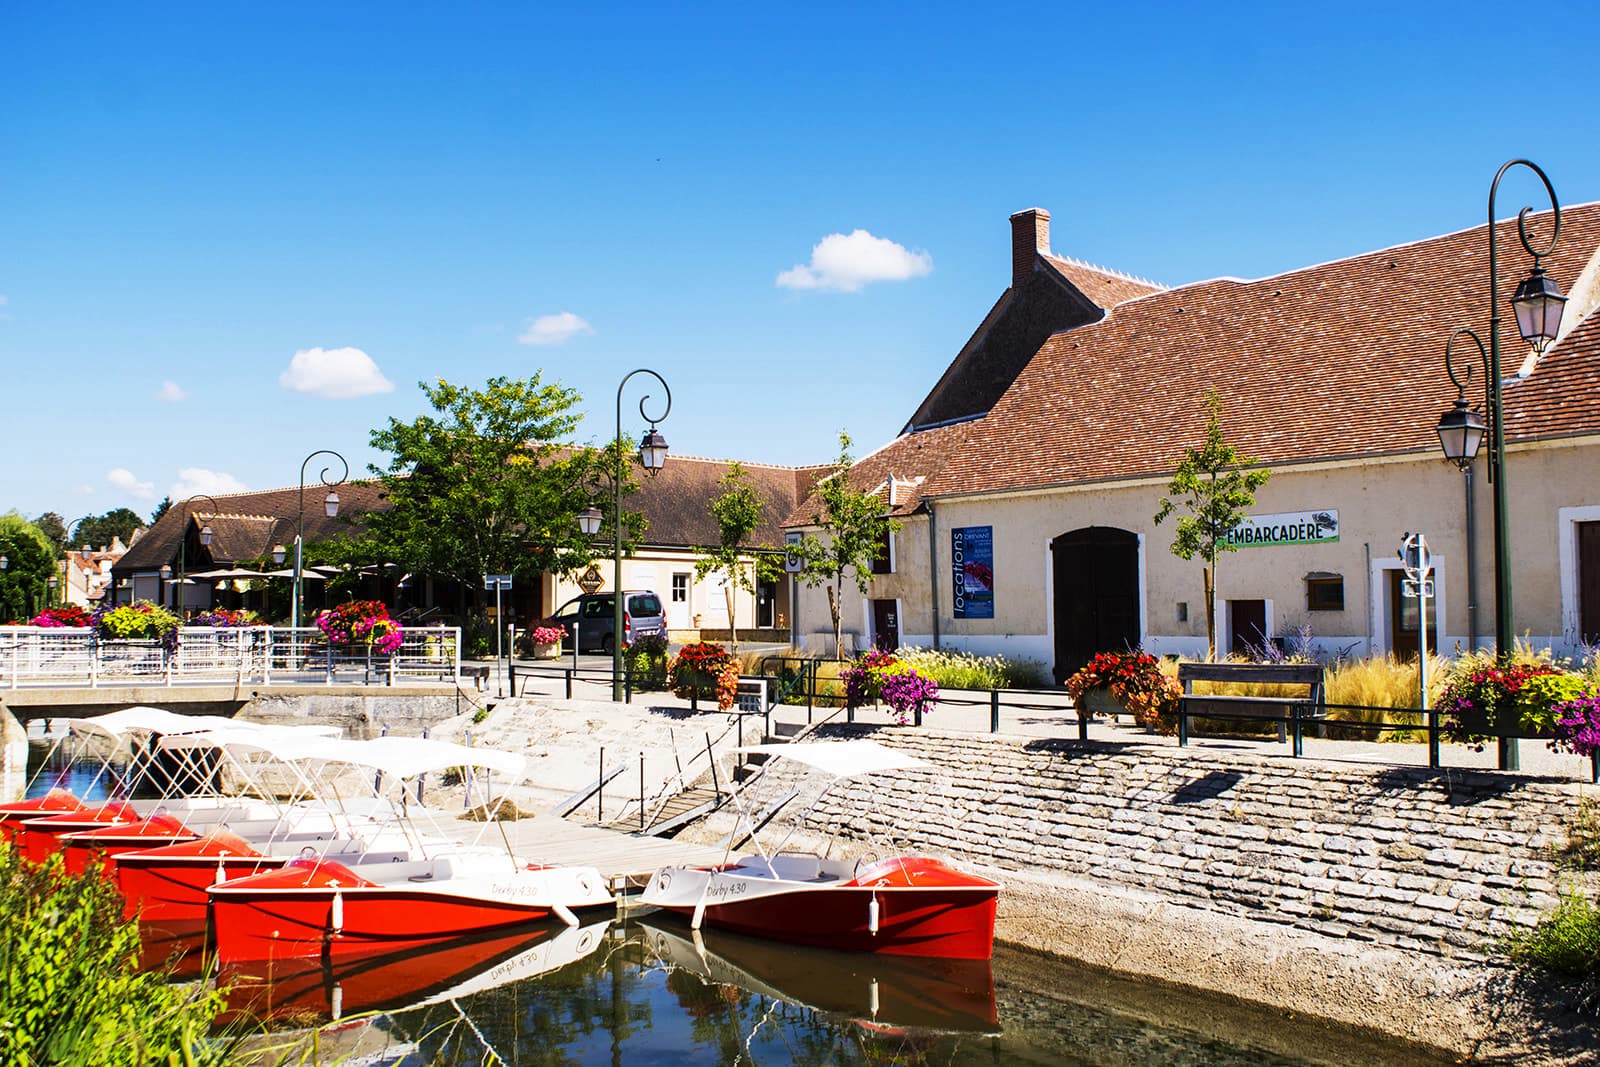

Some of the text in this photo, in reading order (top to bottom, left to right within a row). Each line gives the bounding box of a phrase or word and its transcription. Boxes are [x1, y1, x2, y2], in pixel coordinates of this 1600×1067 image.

[1227, 517, 1324, 545] EMBARCADÈRE
[953, 532, 965, 612] locations
[492, 883, 518, 900] Derby
[707, 883, 729, 901] Derby
